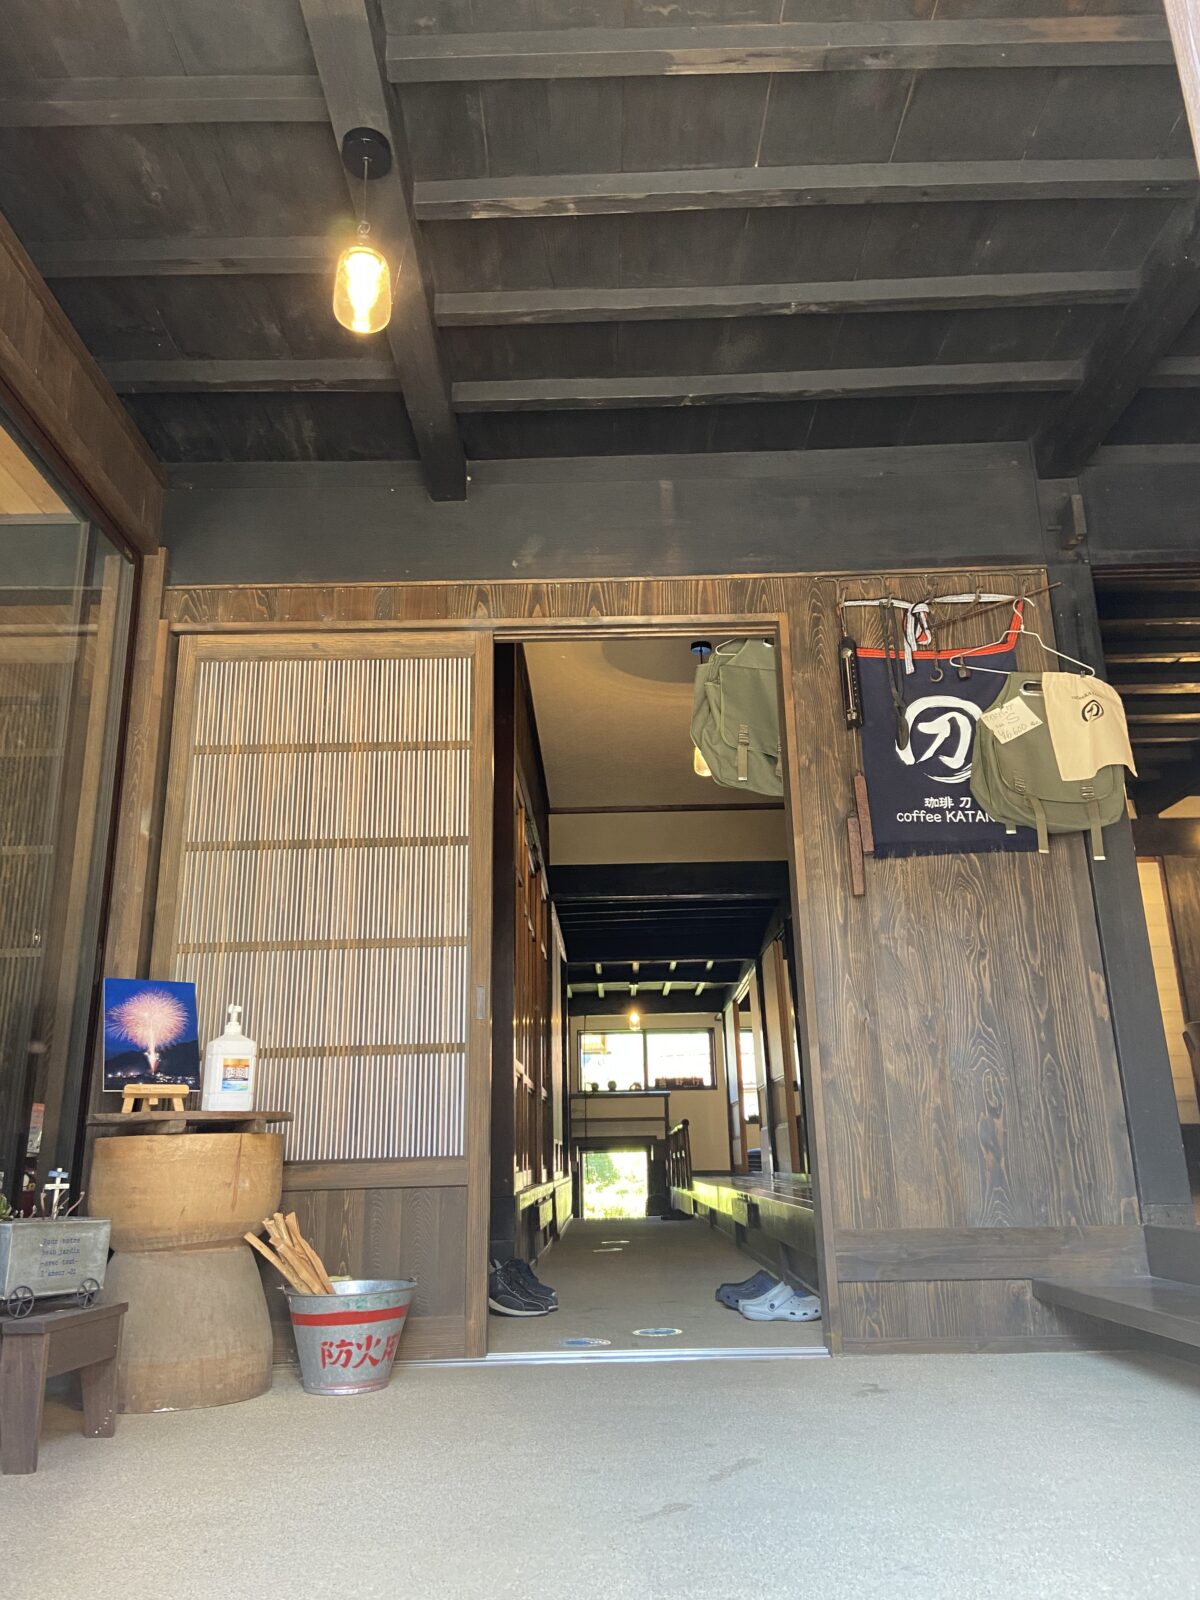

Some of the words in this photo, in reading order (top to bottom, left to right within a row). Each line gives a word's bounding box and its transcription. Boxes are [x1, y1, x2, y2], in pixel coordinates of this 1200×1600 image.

[917, 711, 972, 769] 刀
[924, 796, 954, 809] 珈琲
[959, 797, 972, 809] 刀
[896, 810, 942, 822] coffee
[946, 810, 996, 822] KATAN
